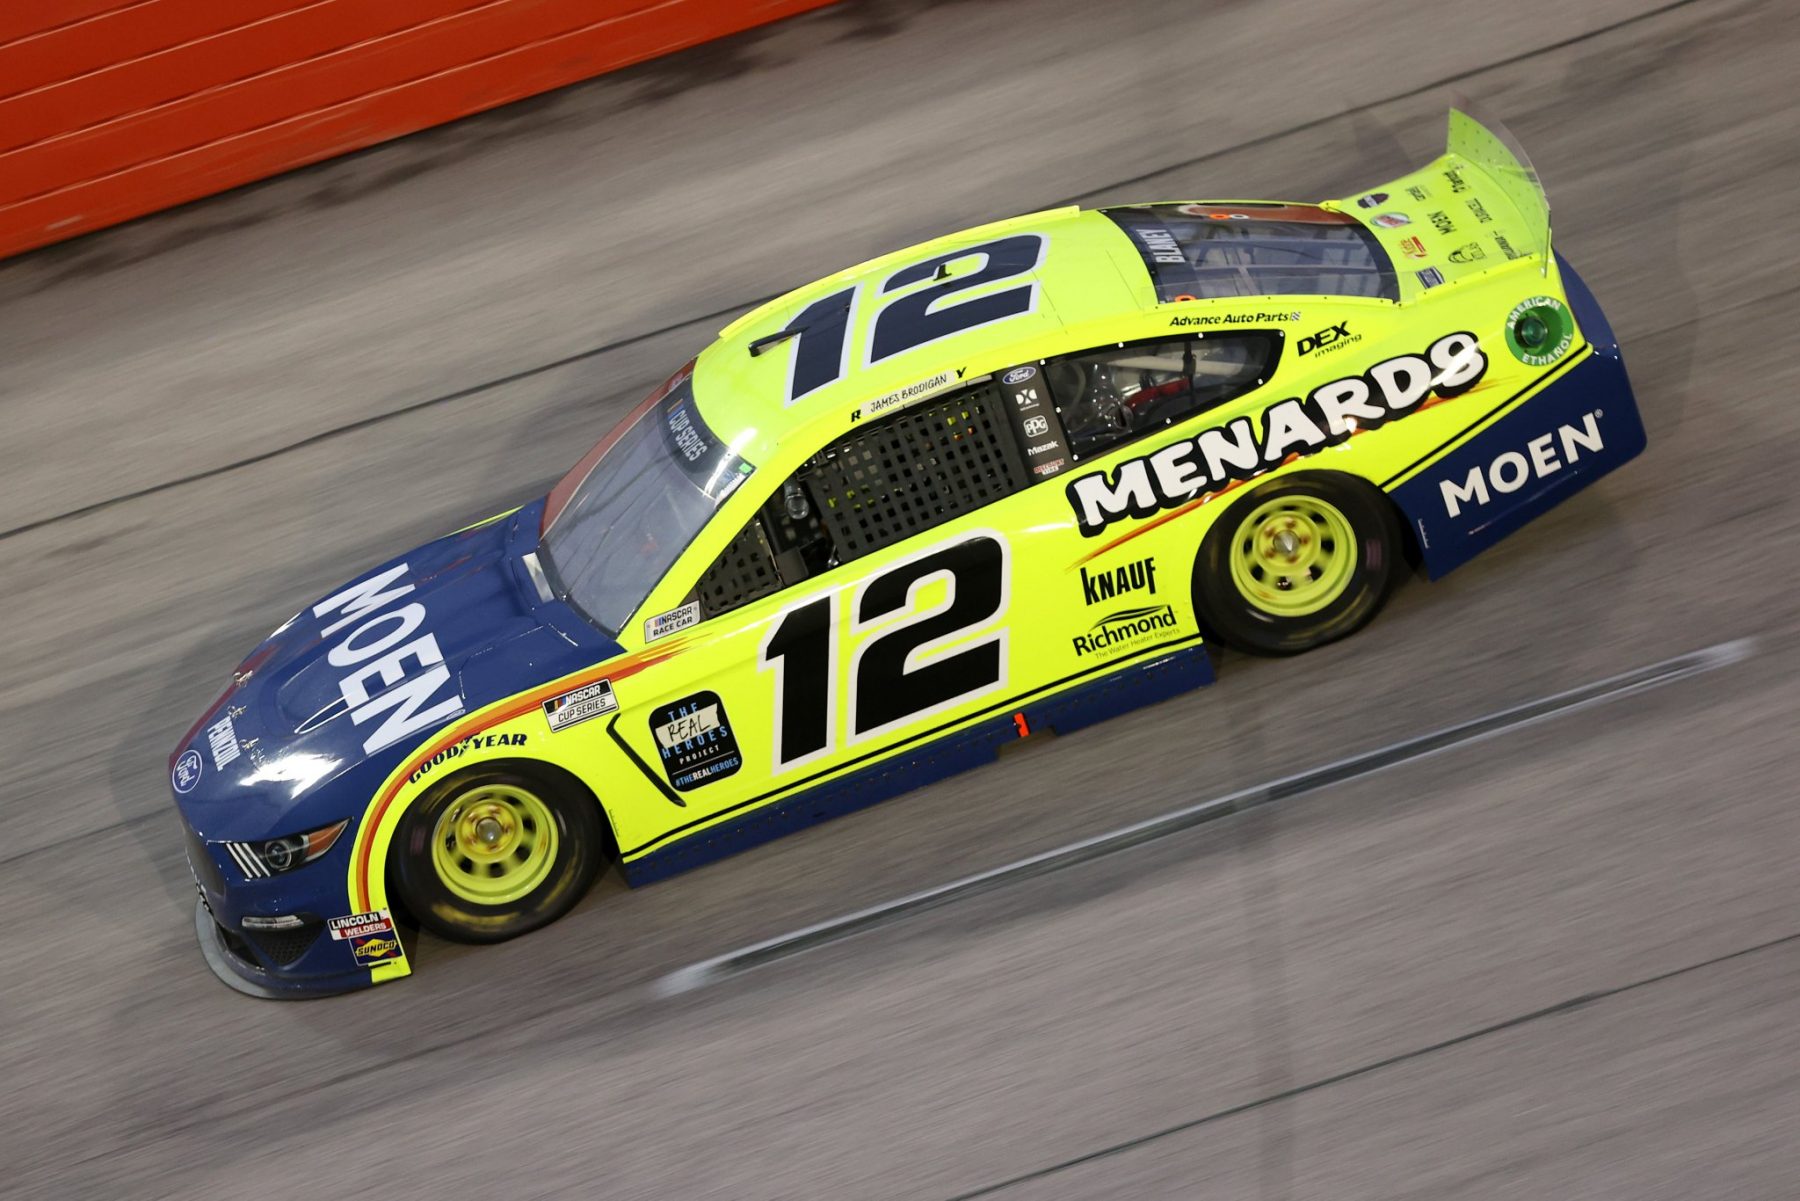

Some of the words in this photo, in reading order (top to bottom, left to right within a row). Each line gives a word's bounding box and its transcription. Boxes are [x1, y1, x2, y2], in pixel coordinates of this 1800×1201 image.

[1427, 210, 1457, 235] MOEN
[1136, 228, 1186, 264] BLANEY
[785, 233, 1048, 407] 12
[1170, 315, 1221, 327] Advance
[1223, 313, 1254, 324] Auto
[1256, 312, 1289, 323] Parts
[1507, 296, 1561, 330] AMERICAN
[1297, 321, 1351, 357] DEX
[1315, 334, 1363, 358] imaging
[1522, 333, 1573, 366] ETHANOL
[870, 394, 900, 413] JAMES
[901, 374, 948, 399] BRODIGAN
[668, 409, 690, 433] CUP
[1068, 332, 1488, 534] MENARDS
[675, 426, 708, 462] SERIES
[1027, 440, 1059, 456] Mazak
[1439, 412, 1604, 519] MOEN
[653, 624, 675, 637] RACE
[677, 616, 693, 629] CAR
[661, 606, 693, 624] NASCAR
[1072, 605, 1177, 657] Richmond
[313, 562, 463, 754] MOEN
[758, 528, 1010, 776] 12
[558, 710, 575, 722] CUP
[577, 698, 606, 716] SERIES
[565, 685, 601, 705] NASCAR
[668, 703, 698, 721] THE
[662, 726, 728, 759] HEROES
[668, 714, 711, 743] REAL
[207, 716, 241, 772] PENNZOIL
[679, 745, 720, 765] PROJECT
[175, 754, 200, 788] Ford
[675, 757, 739, 787] #THEREALHEROES
[331, 913, 379, 929] LINCOLN
[344, 922, 387, 937] WELDERS
[357, 941, 396, 956] SUNOCO
